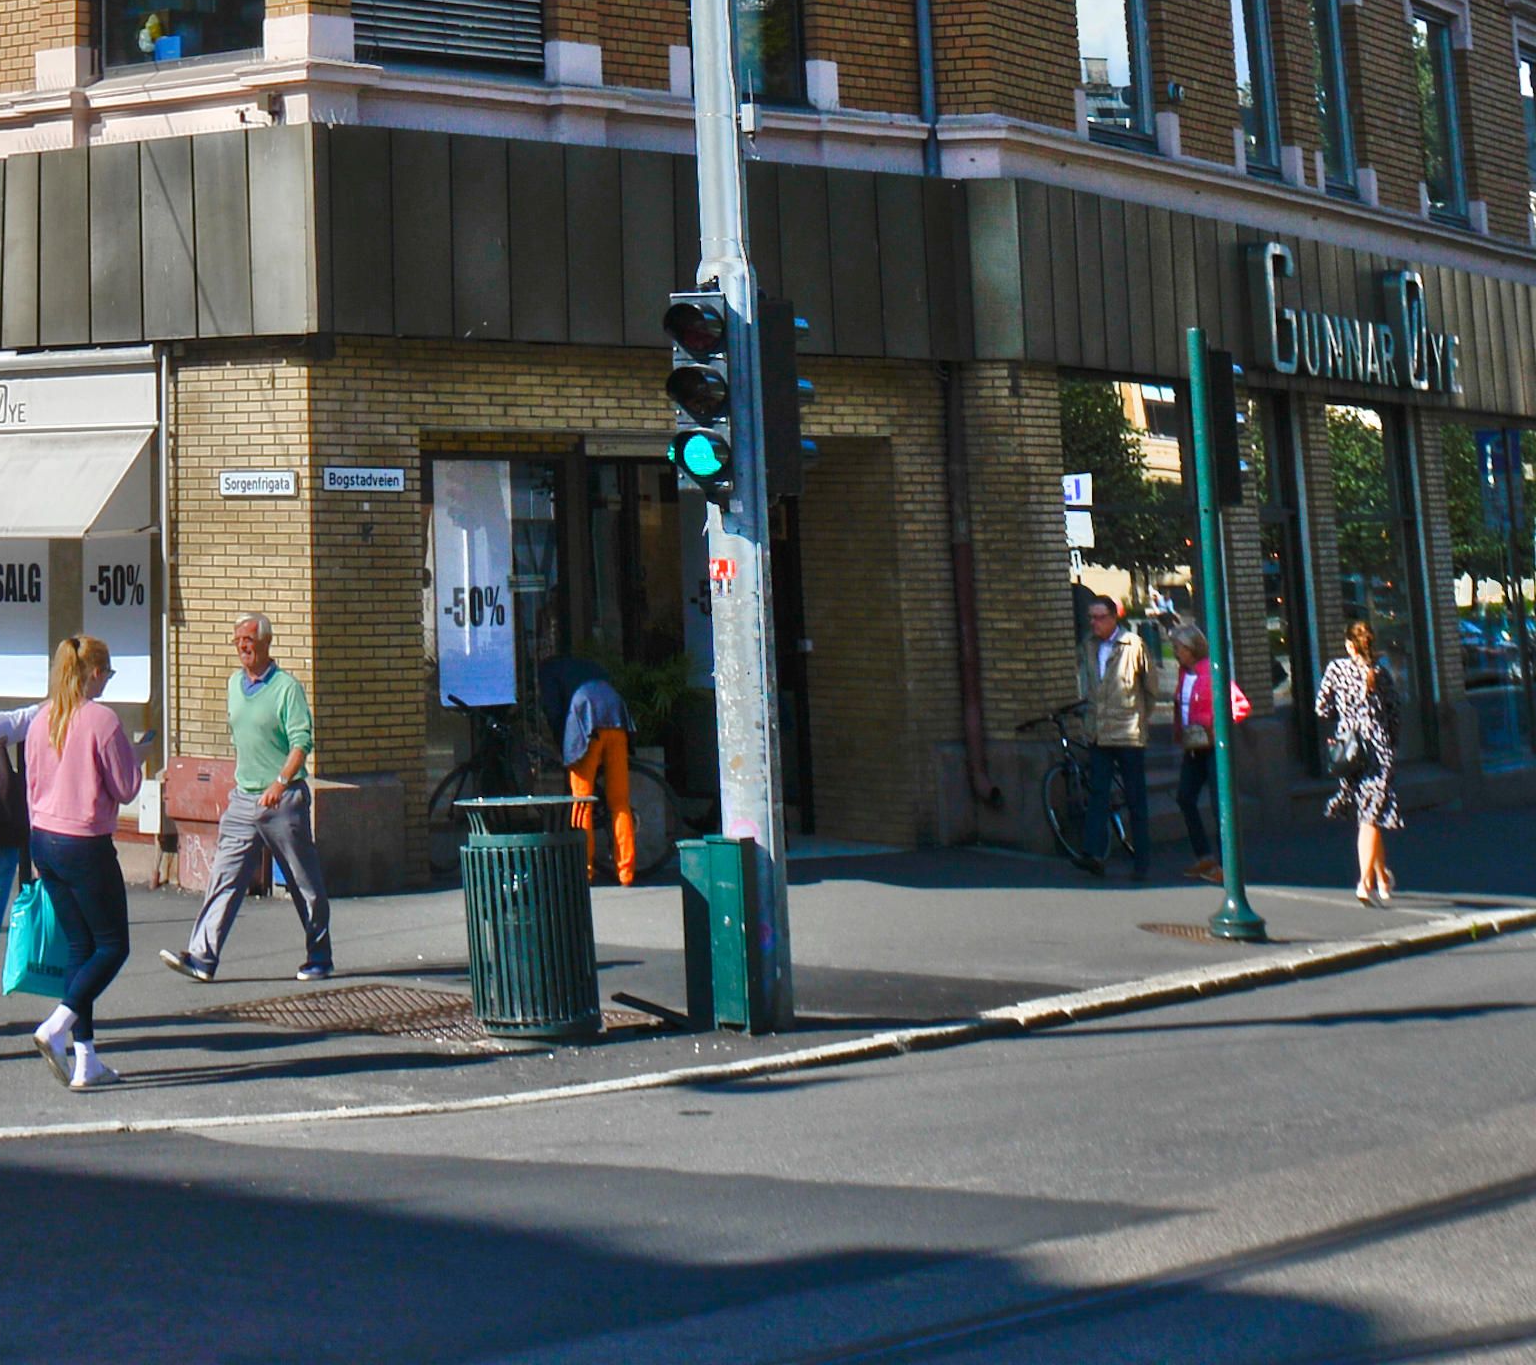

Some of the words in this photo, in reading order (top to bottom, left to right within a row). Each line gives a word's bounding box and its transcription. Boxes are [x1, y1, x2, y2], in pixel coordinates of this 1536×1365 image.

[224, 476, 291, 494] Sorgenfrigata
[328, 471, 401, 489] Bogstadveien
[88, 564, 145, 606] -50%
[443, 584, 506, 628] -50%
